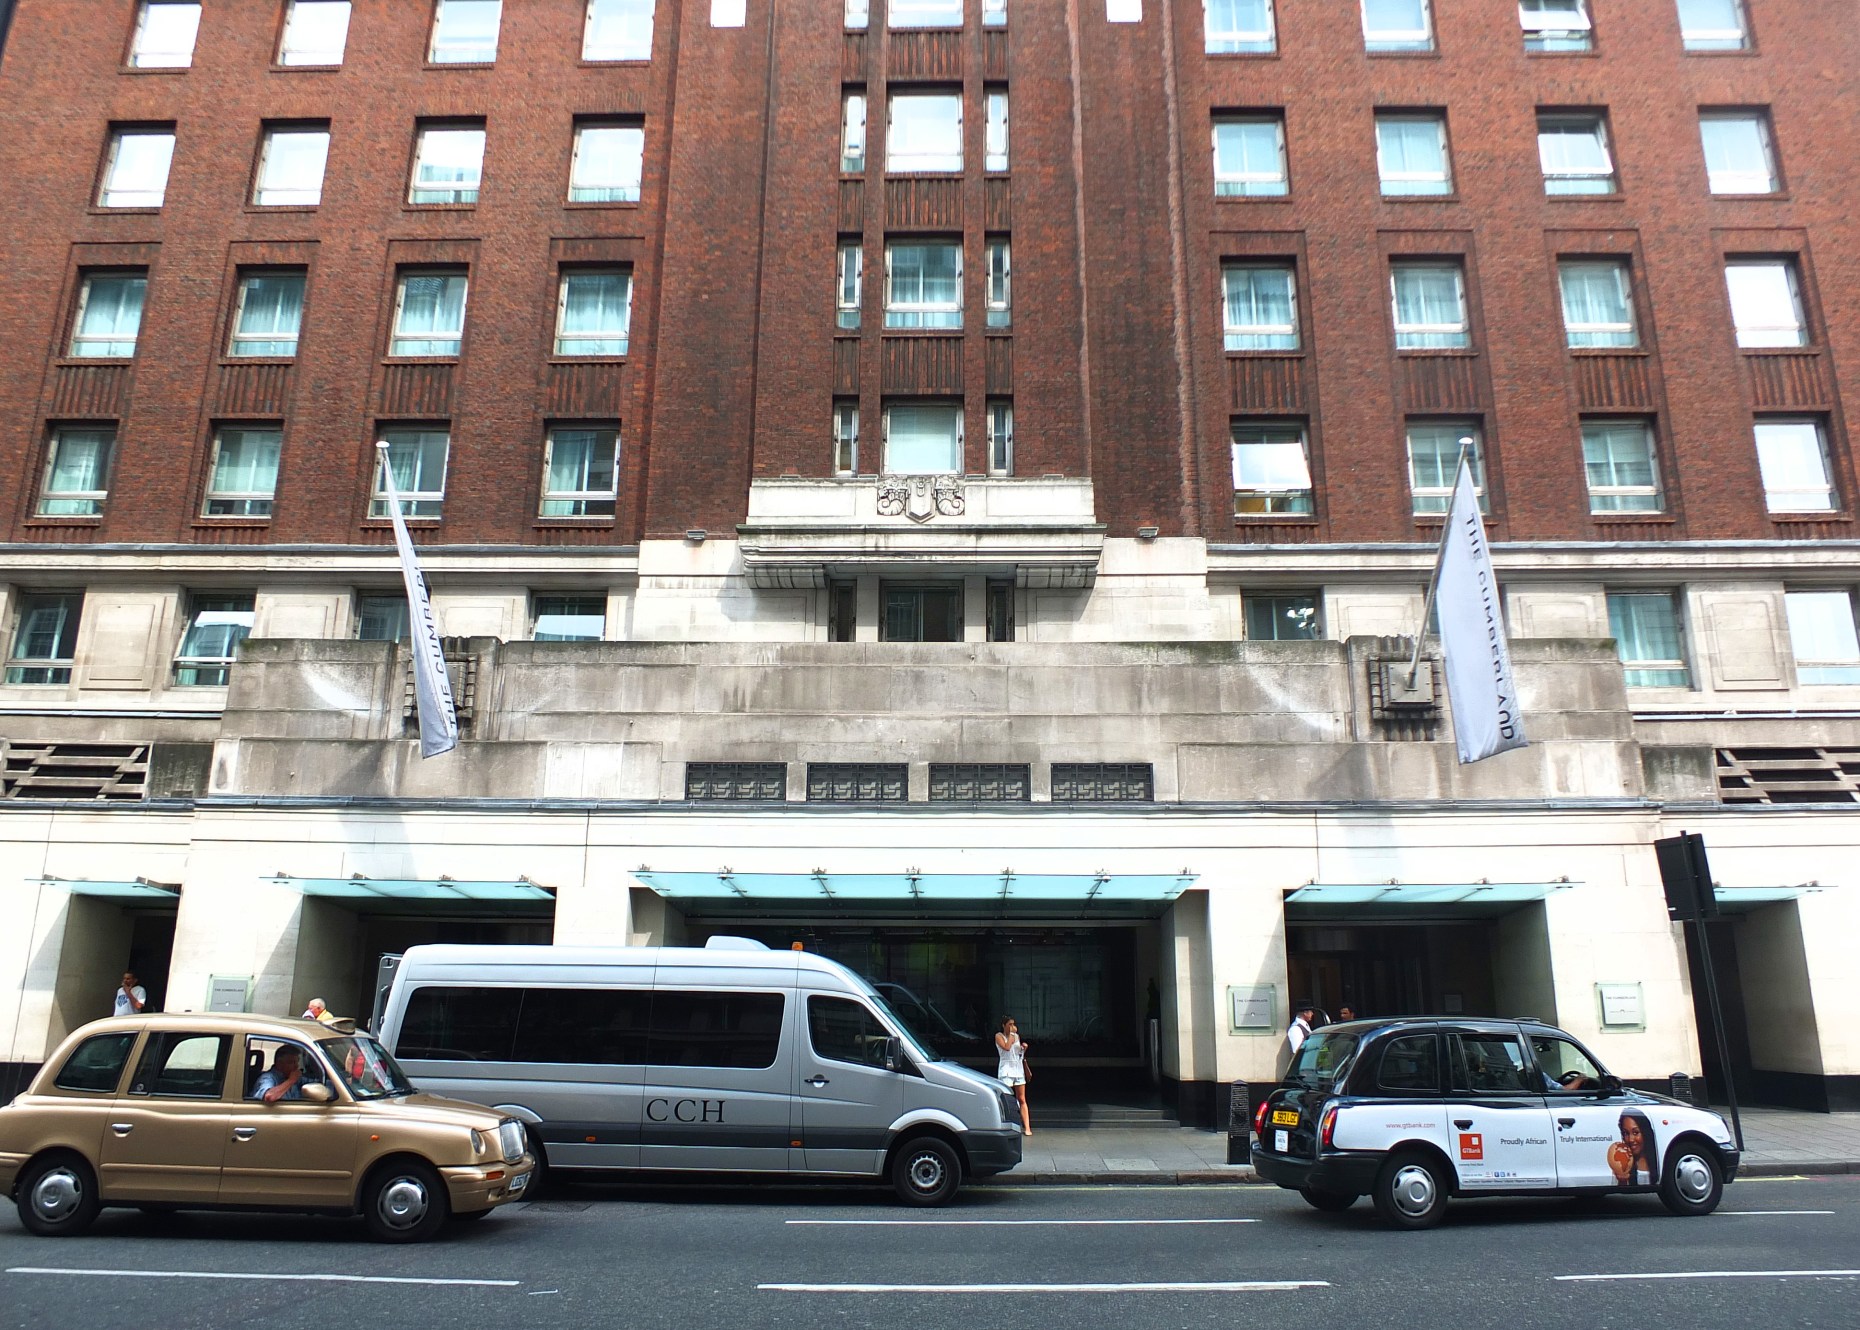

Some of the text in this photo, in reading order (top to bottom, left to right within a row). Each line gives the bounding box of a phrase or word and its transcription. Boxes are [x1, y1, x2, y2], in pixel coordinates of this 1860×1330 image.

[1466, 514, 1482, 562] THE
[414, 565, 456, 729] THE CUMBER
[646, 1098, 725, 1123] CCH
[1385, 1121, 1436, 1130] www.gtbank.com
[1500, 1138, 1524, 1147] Proudly
[1559, 1134, 1613, 1144] Truly International
